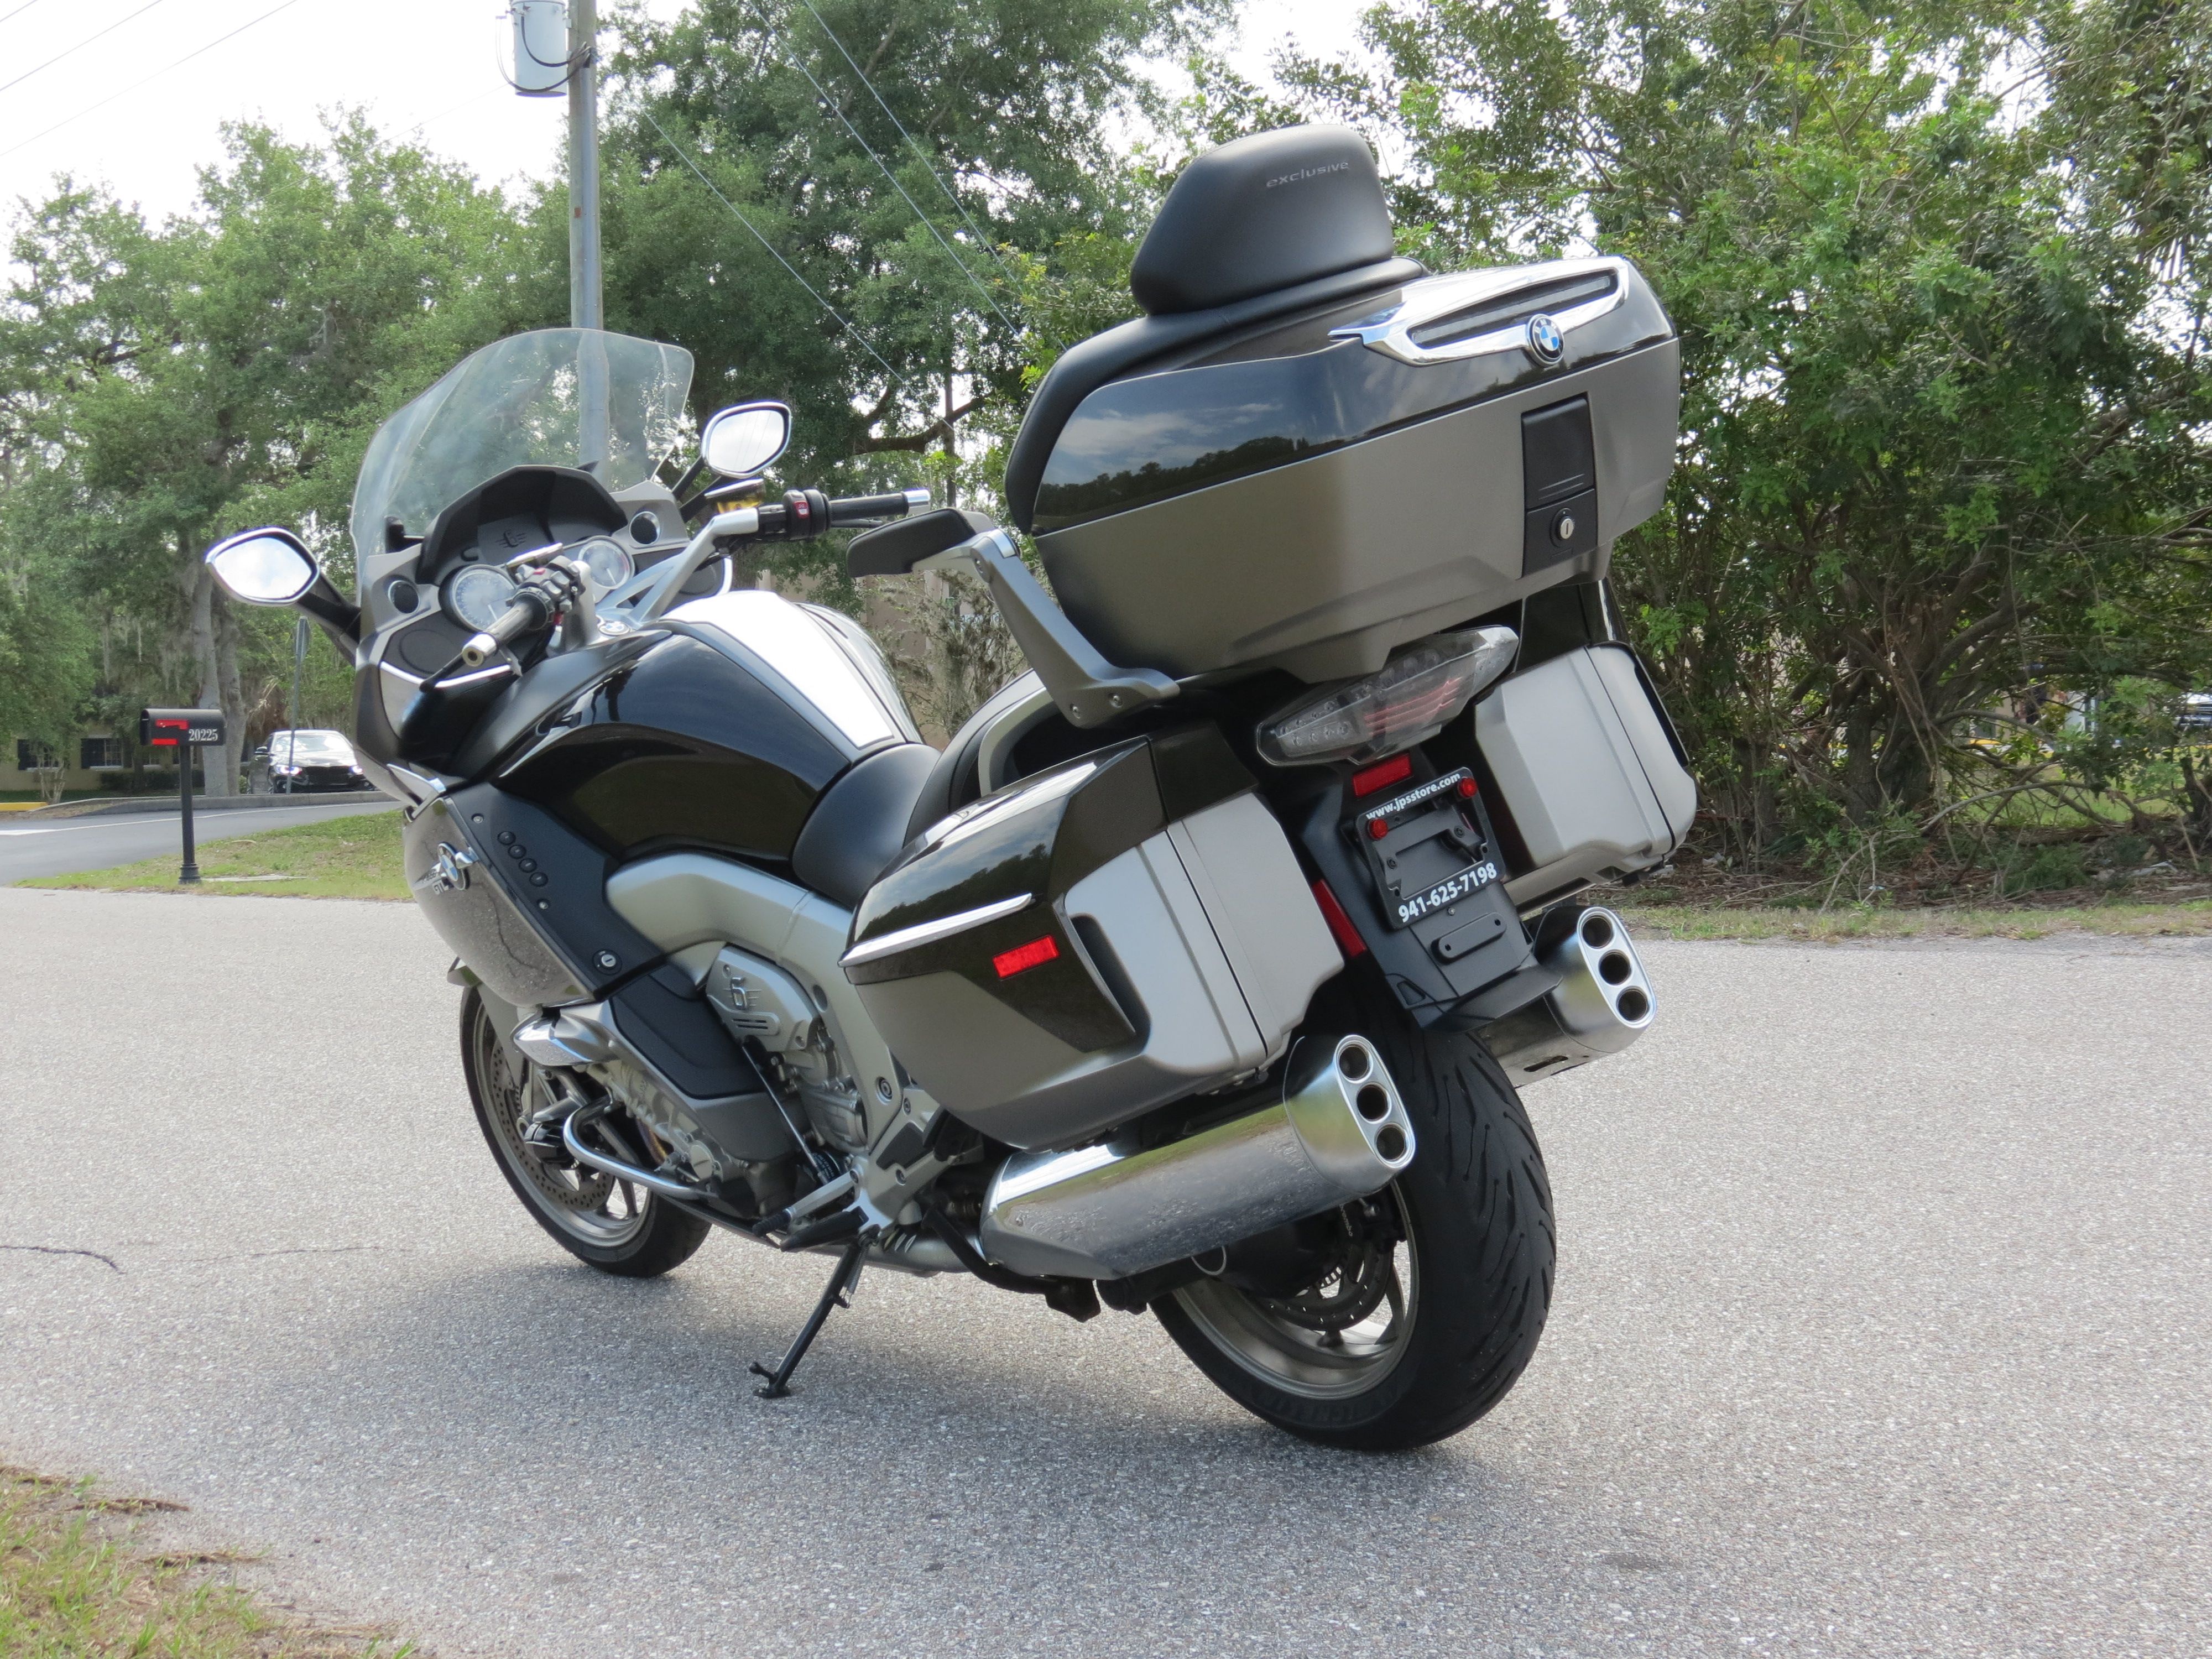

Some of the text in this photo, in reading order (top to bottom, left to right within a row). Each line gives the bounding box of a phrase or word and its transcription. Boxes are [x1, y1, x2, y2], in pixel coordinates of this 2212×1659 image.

[1266, 161, 1349, 187] exclusive
[189, 729, 218, 741] 20225
[1366, 773, 1460, 820] www.jpsstore.com
[1398, 862, 1497, 922] 941-625-7198
